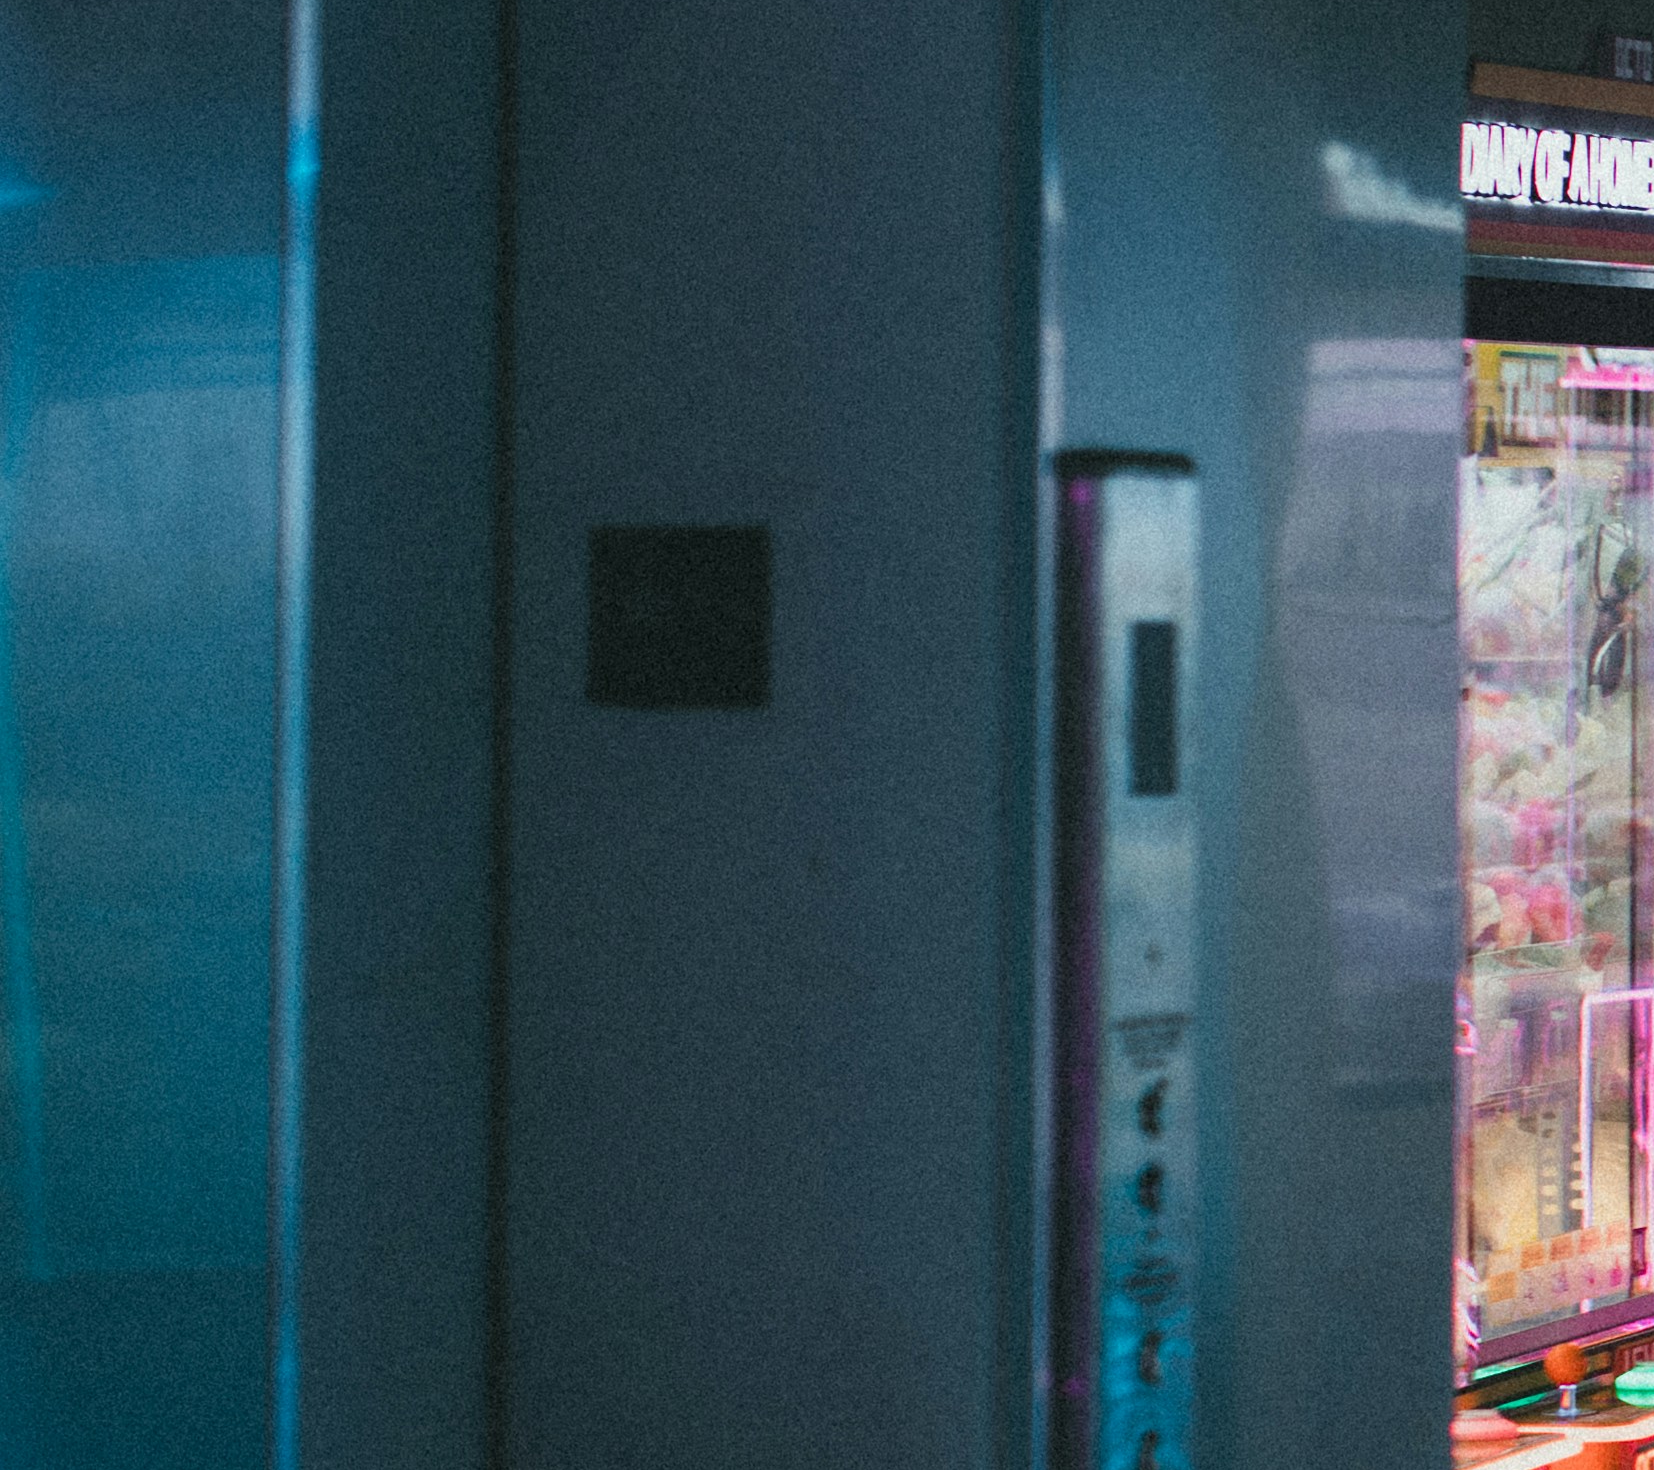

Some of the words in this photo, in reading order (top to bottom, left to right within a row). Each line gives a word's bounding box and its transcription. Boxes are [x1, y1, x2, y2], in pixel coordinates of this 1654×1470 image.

[1461, 122, 1537, 198] DIARY
[1535, 130, 1571, 202] OF
[1567, 134, 1590, 203] A
